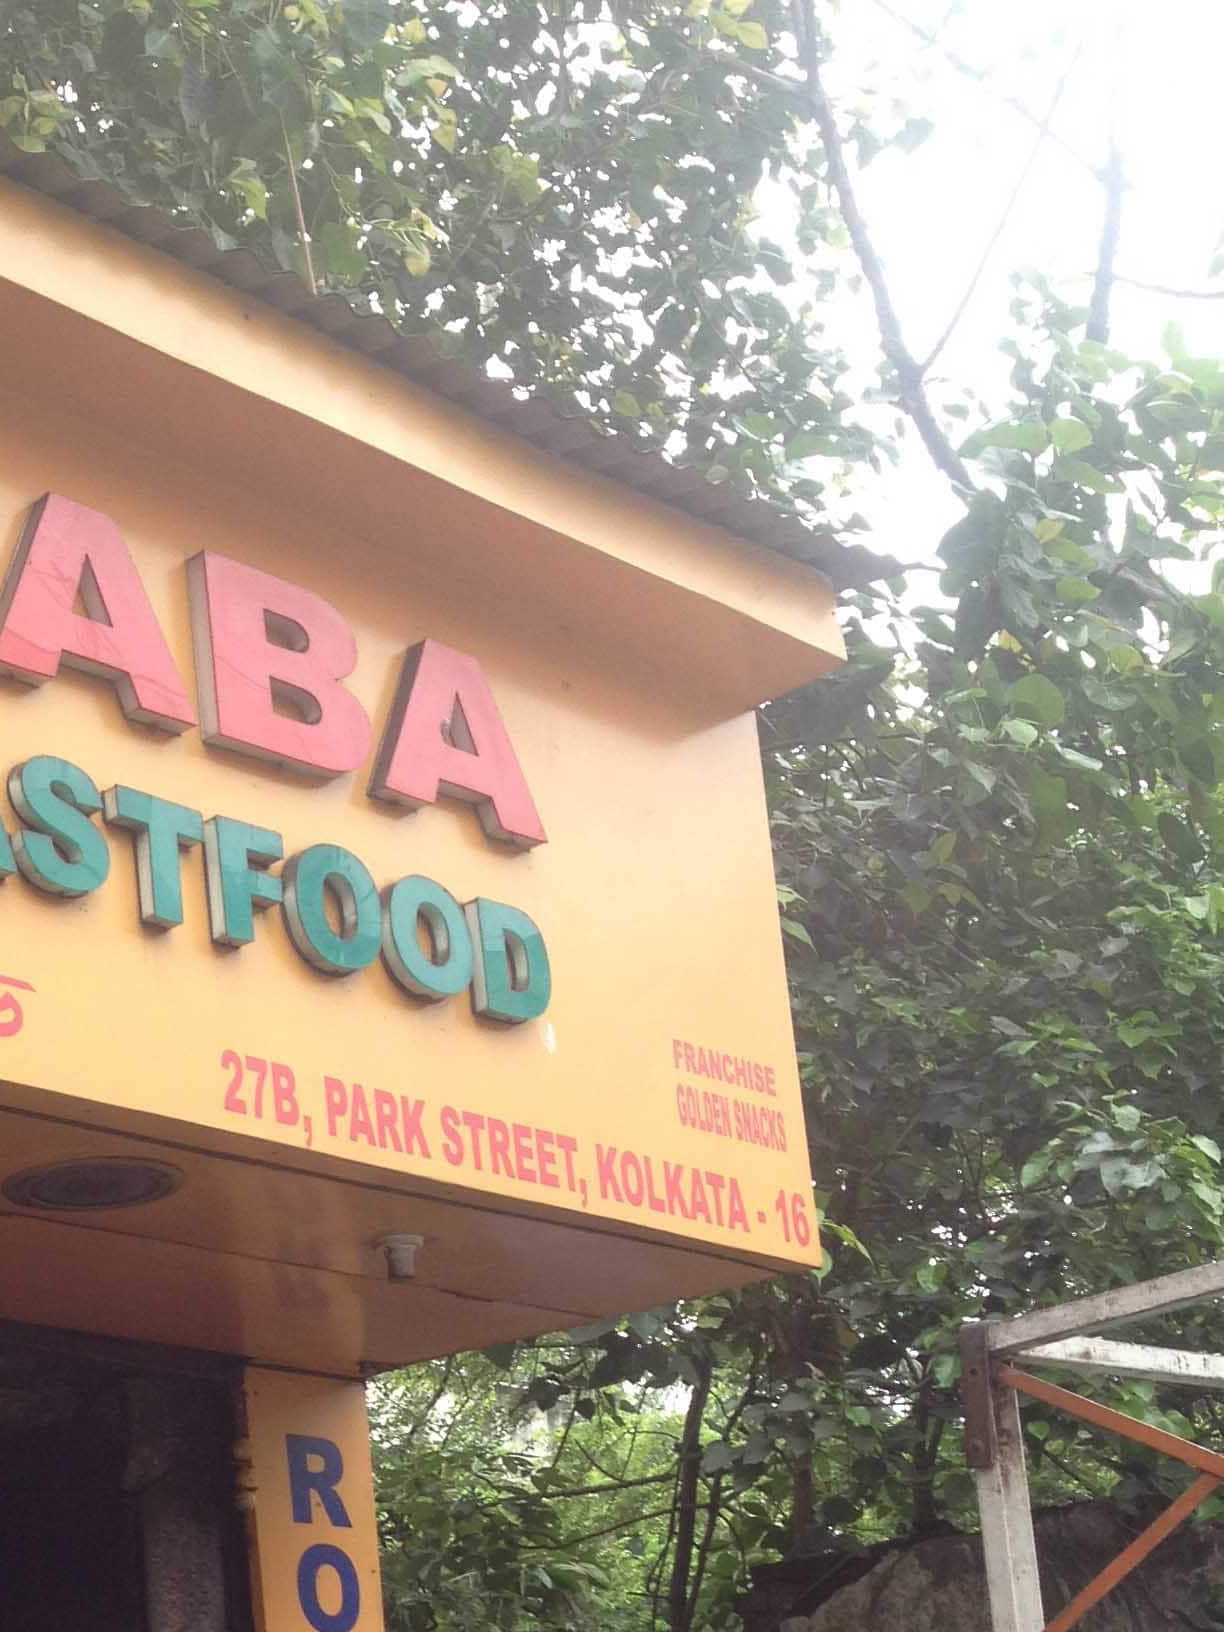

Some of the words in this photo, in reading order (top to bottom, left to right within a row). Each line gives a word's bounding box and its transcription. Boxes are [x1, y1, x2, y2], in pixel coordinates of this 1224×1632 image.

[672, 1039, 777, 1097] FRANCHISE
[221, 1048, 313, 1147] 27B,
[324, 1075, 432, 1159] PARK
[440, 1105, 589, 1208] STREET,
[595, 1143, 750, 1233] KOLKATA
[776, 1189, 810, 1247] 16
[676, 1083, 733, 1139] GOLDEN
[733, 1098, 787, 1153] SNACKS
